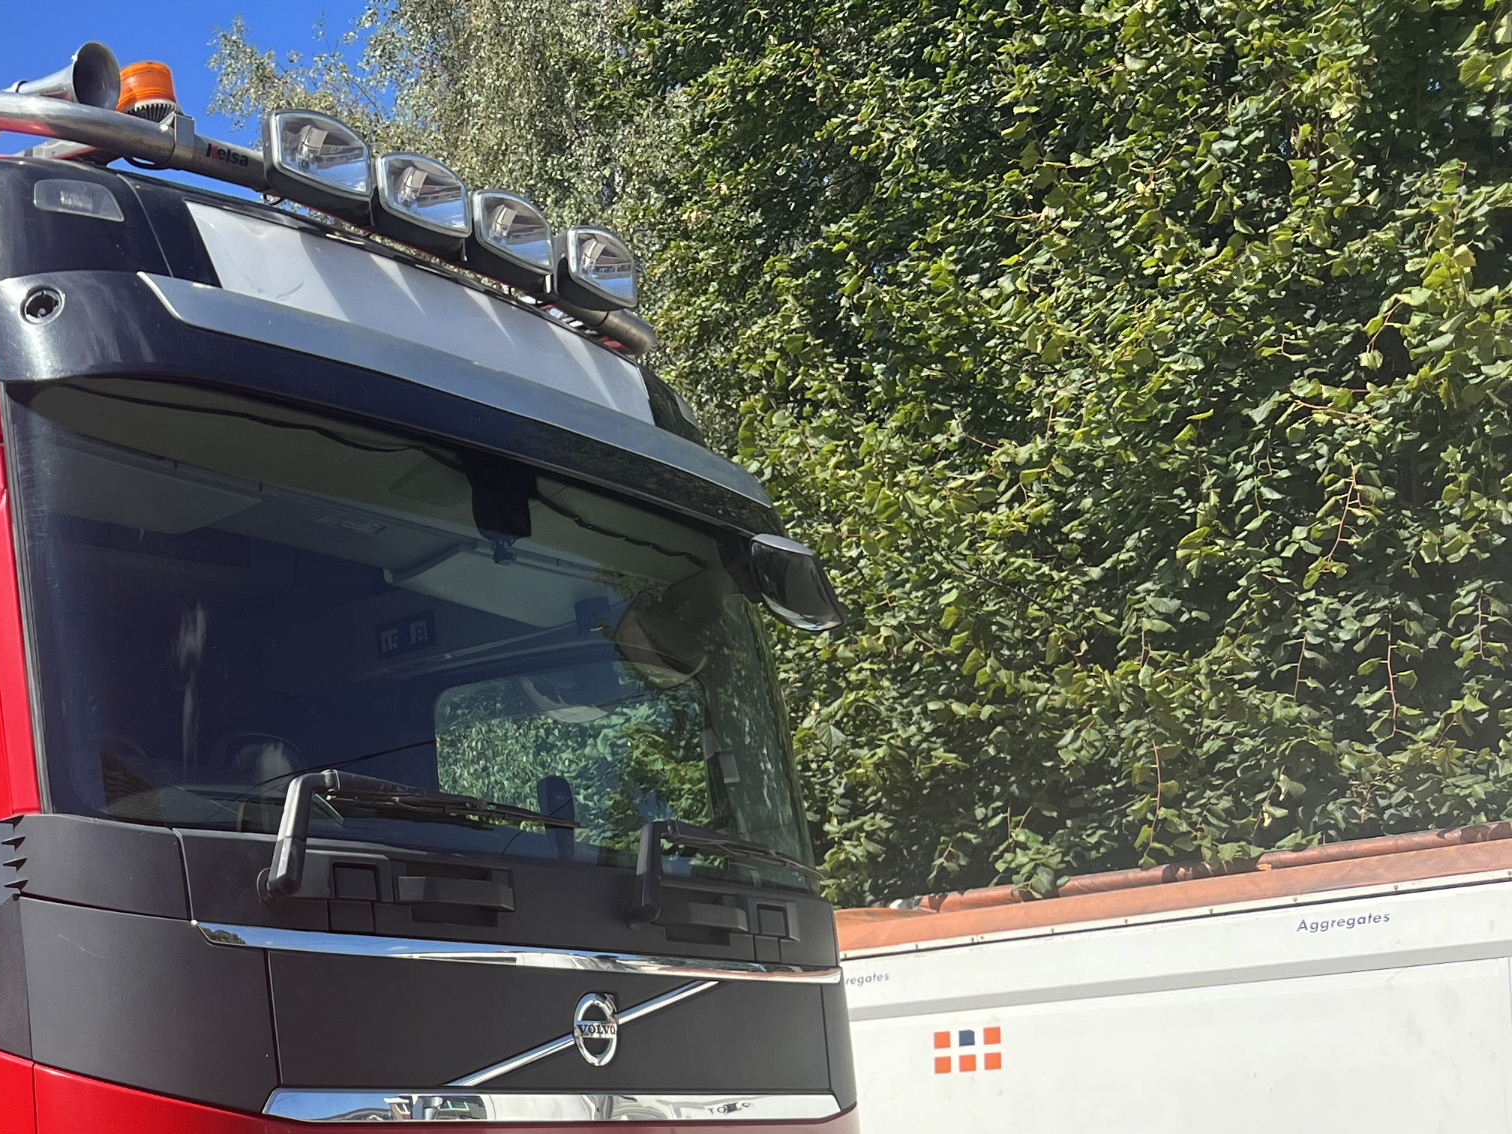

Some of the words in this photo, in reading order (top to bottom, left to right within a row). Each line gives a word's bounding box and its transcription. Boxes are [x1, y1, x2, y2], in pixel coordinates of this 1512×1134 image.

[1296, 912, 1391, 934] Aggregates
[845, 971, 890, 987] regates
[576, 1024, 616, 1035] VOLVO
